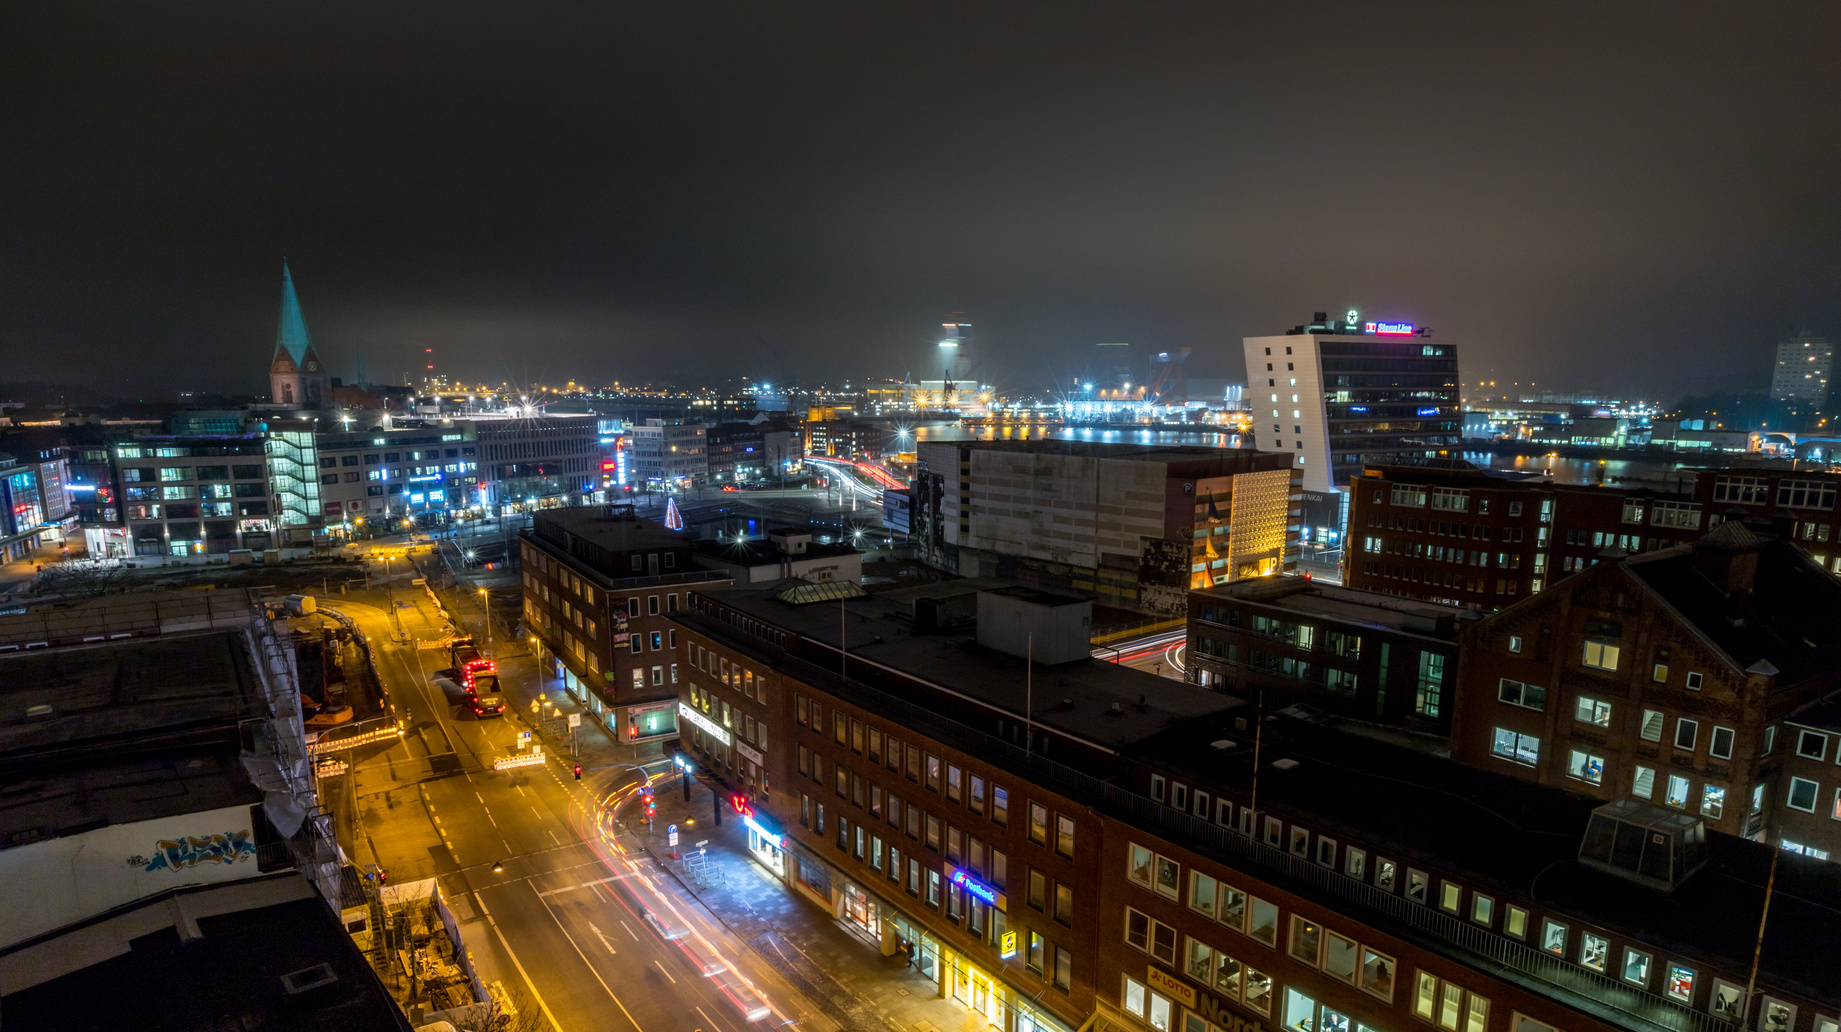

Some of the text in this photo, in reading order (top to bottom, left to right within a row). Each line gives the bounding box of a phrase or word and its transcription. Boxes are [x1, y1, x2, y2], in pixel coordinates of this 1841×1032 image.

[1377, 323, 1412, 332] Stena Line
[616, 452, 626, 485] SATURN
[1269, 557, 1278, 572] P
[965, 878, 995, 902] Postbank
[1162, 978, 1191, 998] LOTTO
